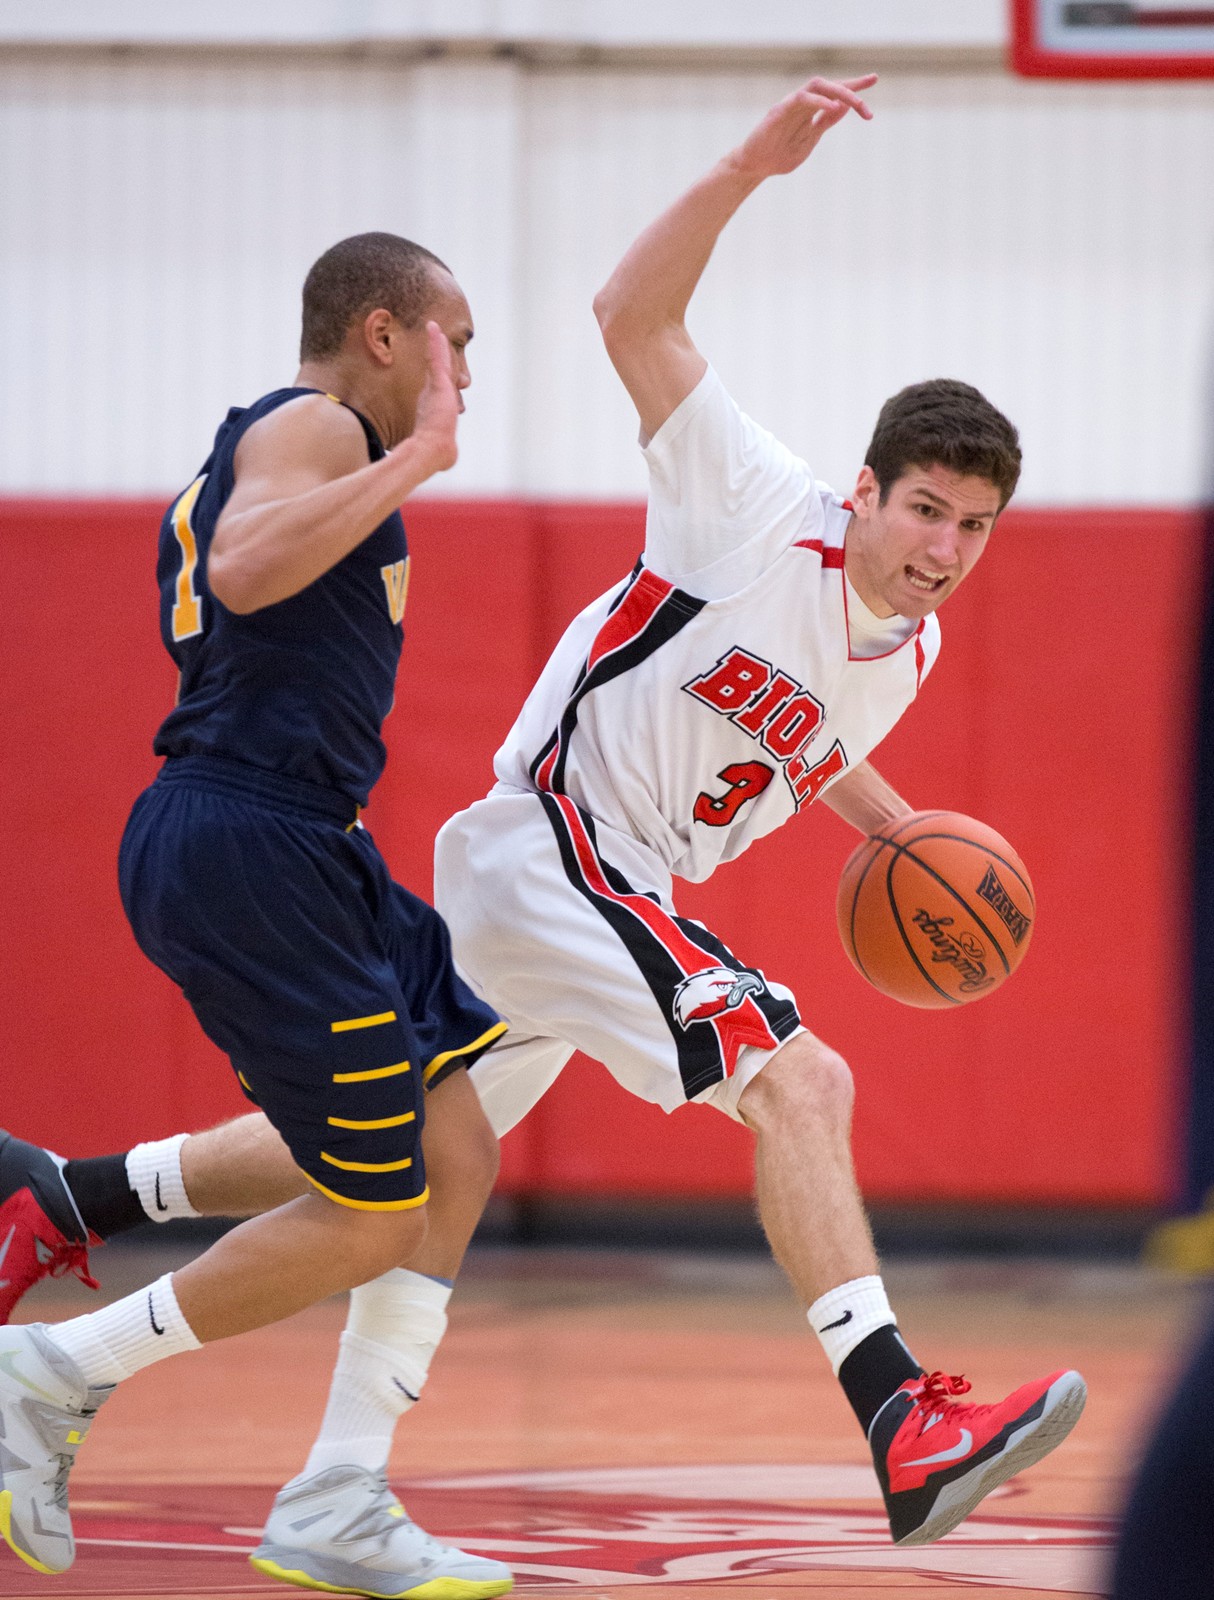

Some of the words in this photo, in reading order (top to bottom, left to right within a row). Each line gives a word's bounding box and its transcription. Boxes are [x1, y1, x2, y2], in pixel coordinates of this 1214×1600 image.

[171, 473, 209, 642] 1
[693, 760, 775, 827] 3
[976, 864, 1031, 948] NAIA
[912, 908, 995, 993] Rawlings
